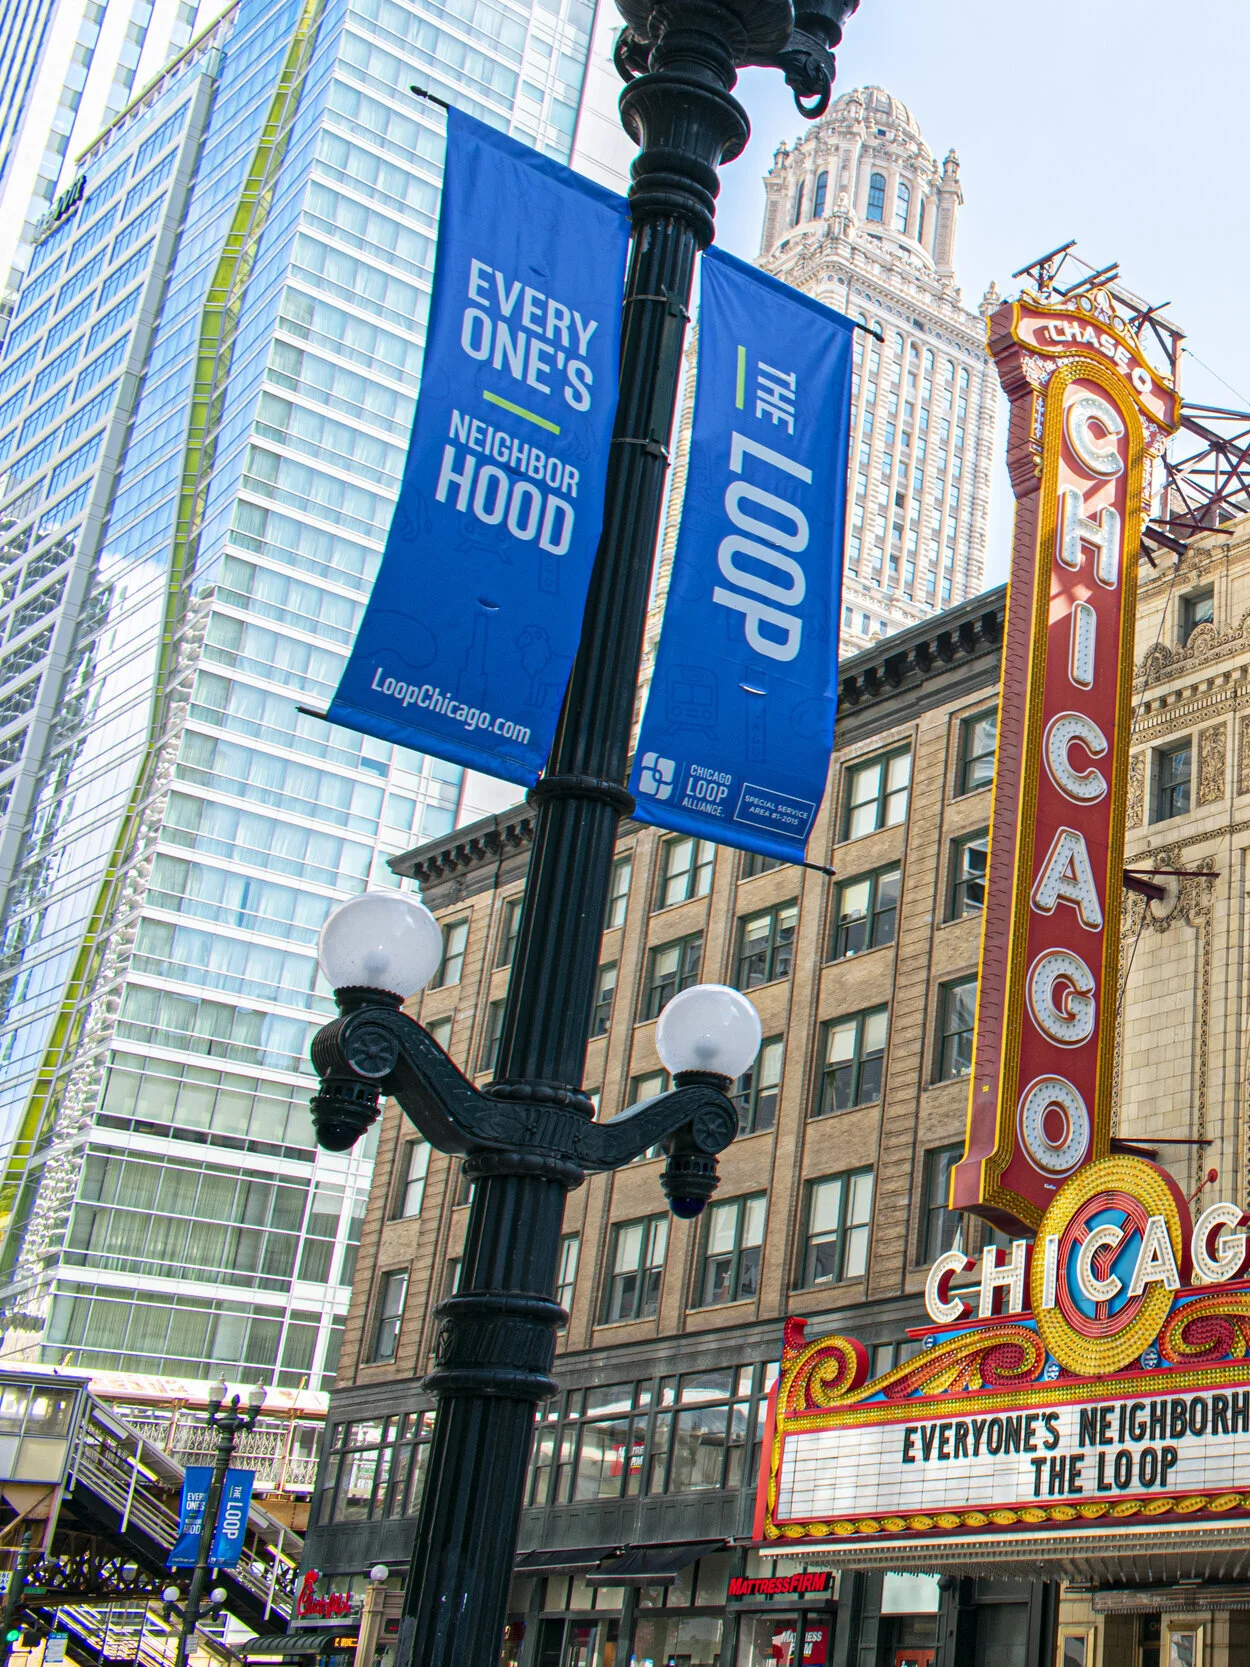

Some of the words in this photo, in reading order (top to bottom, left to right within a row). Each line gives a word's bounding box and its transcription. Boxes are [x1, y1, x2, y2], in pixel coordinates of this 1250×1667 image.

[467, 257, 599, 357] EVERY
[461, 307, 593, 412] ONE'S
[1047, 320, 1132, 373] CHASE
[756, 361, 796, 435] THE
[449, 409, 580, 498] NEIGHBOR
[435, 444, 575, 556] HOOD
[713, 431, 812, 662] LOOP
[371, 667, 531, 744] LoopChicago.com
[686, 777, 728, 803] LOOP
[690, 764, 732, 786] CHICAGO
[1017, 395, 1126, 1179] CHICAGO
[681, 797, 723, 817] ALLIANCE
[744, 795, 776, 811] SPECIAL
[777, 804, 809, 819] SERVICE
[748, 806, 770, 818] AREA
[771, 810, 799, 826] #1-2015
[902, 1411, 1061, 1464] EVERYONE'S
[233, 1486, 242, 1499] THE
[1031, 1453, 1085, 1497] THE
[1097, 1445, 1178, 1492] LOOP
[222, 1501, 243, 1539] LOOP
